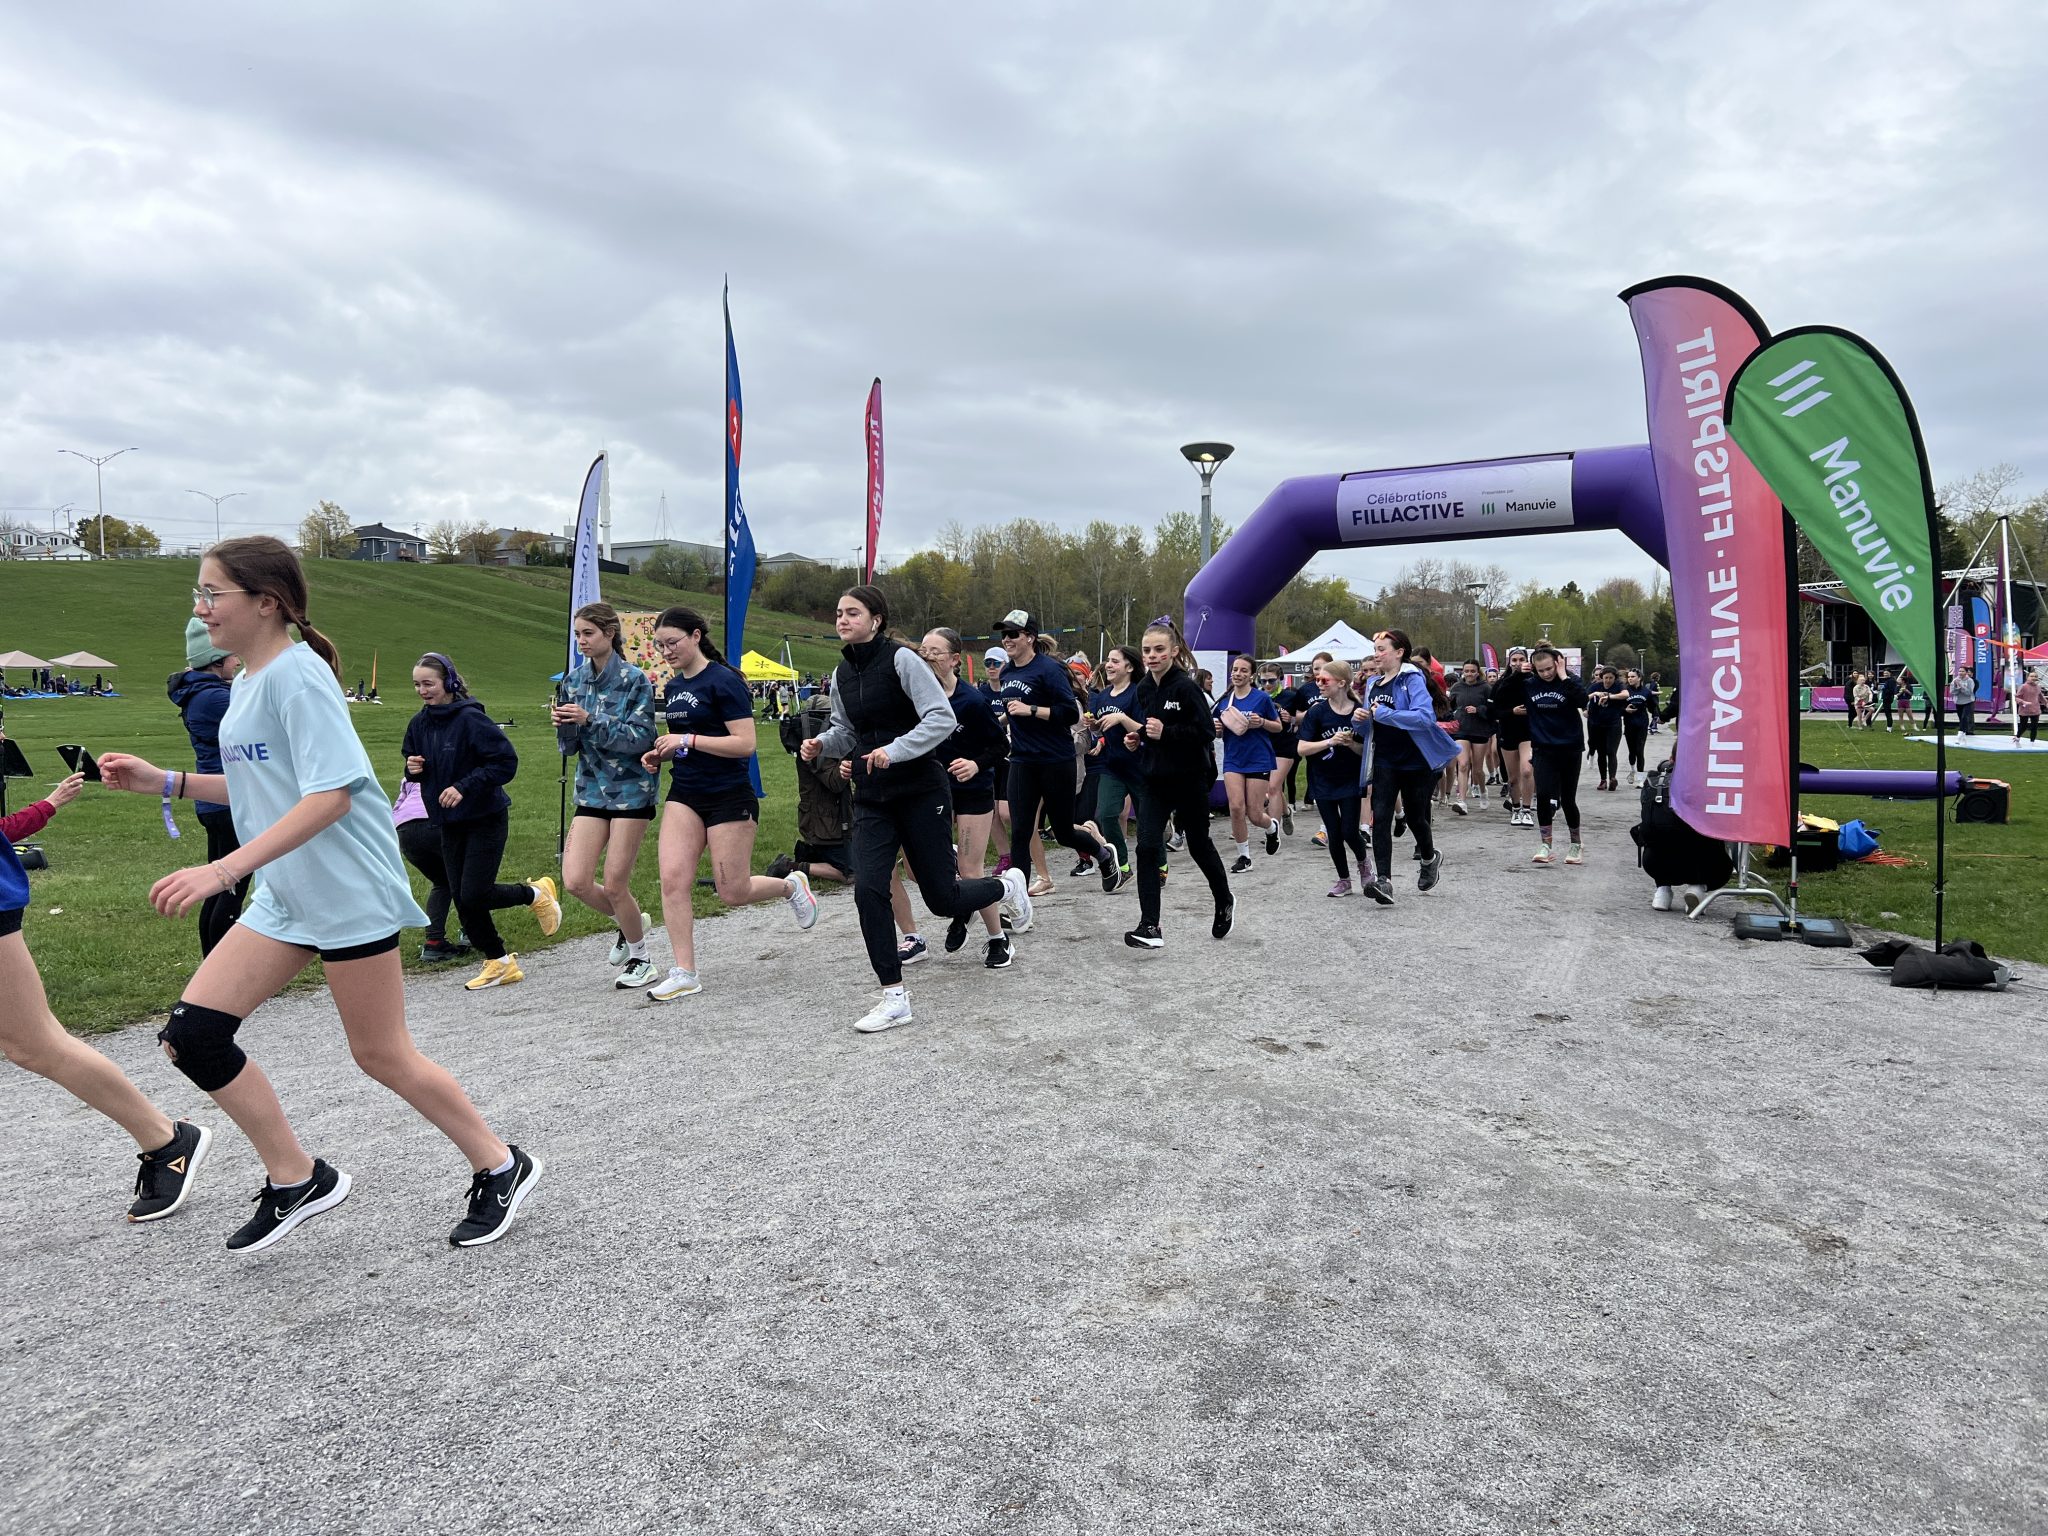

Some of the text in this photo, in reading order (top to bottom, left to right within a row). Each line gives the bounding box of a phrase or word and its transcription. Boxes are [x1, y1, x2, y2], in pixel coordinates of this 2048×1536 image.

[1367, 489, 1447, 505] Célébrations
[1352, 501, 1465, 526] FILLACTIVE
[1506, 498, 1557, 513] Manuvie
[1808, 436, 1916, 612] Manuvie
[1531, 691, 1566, 702] FILLACTIVE
